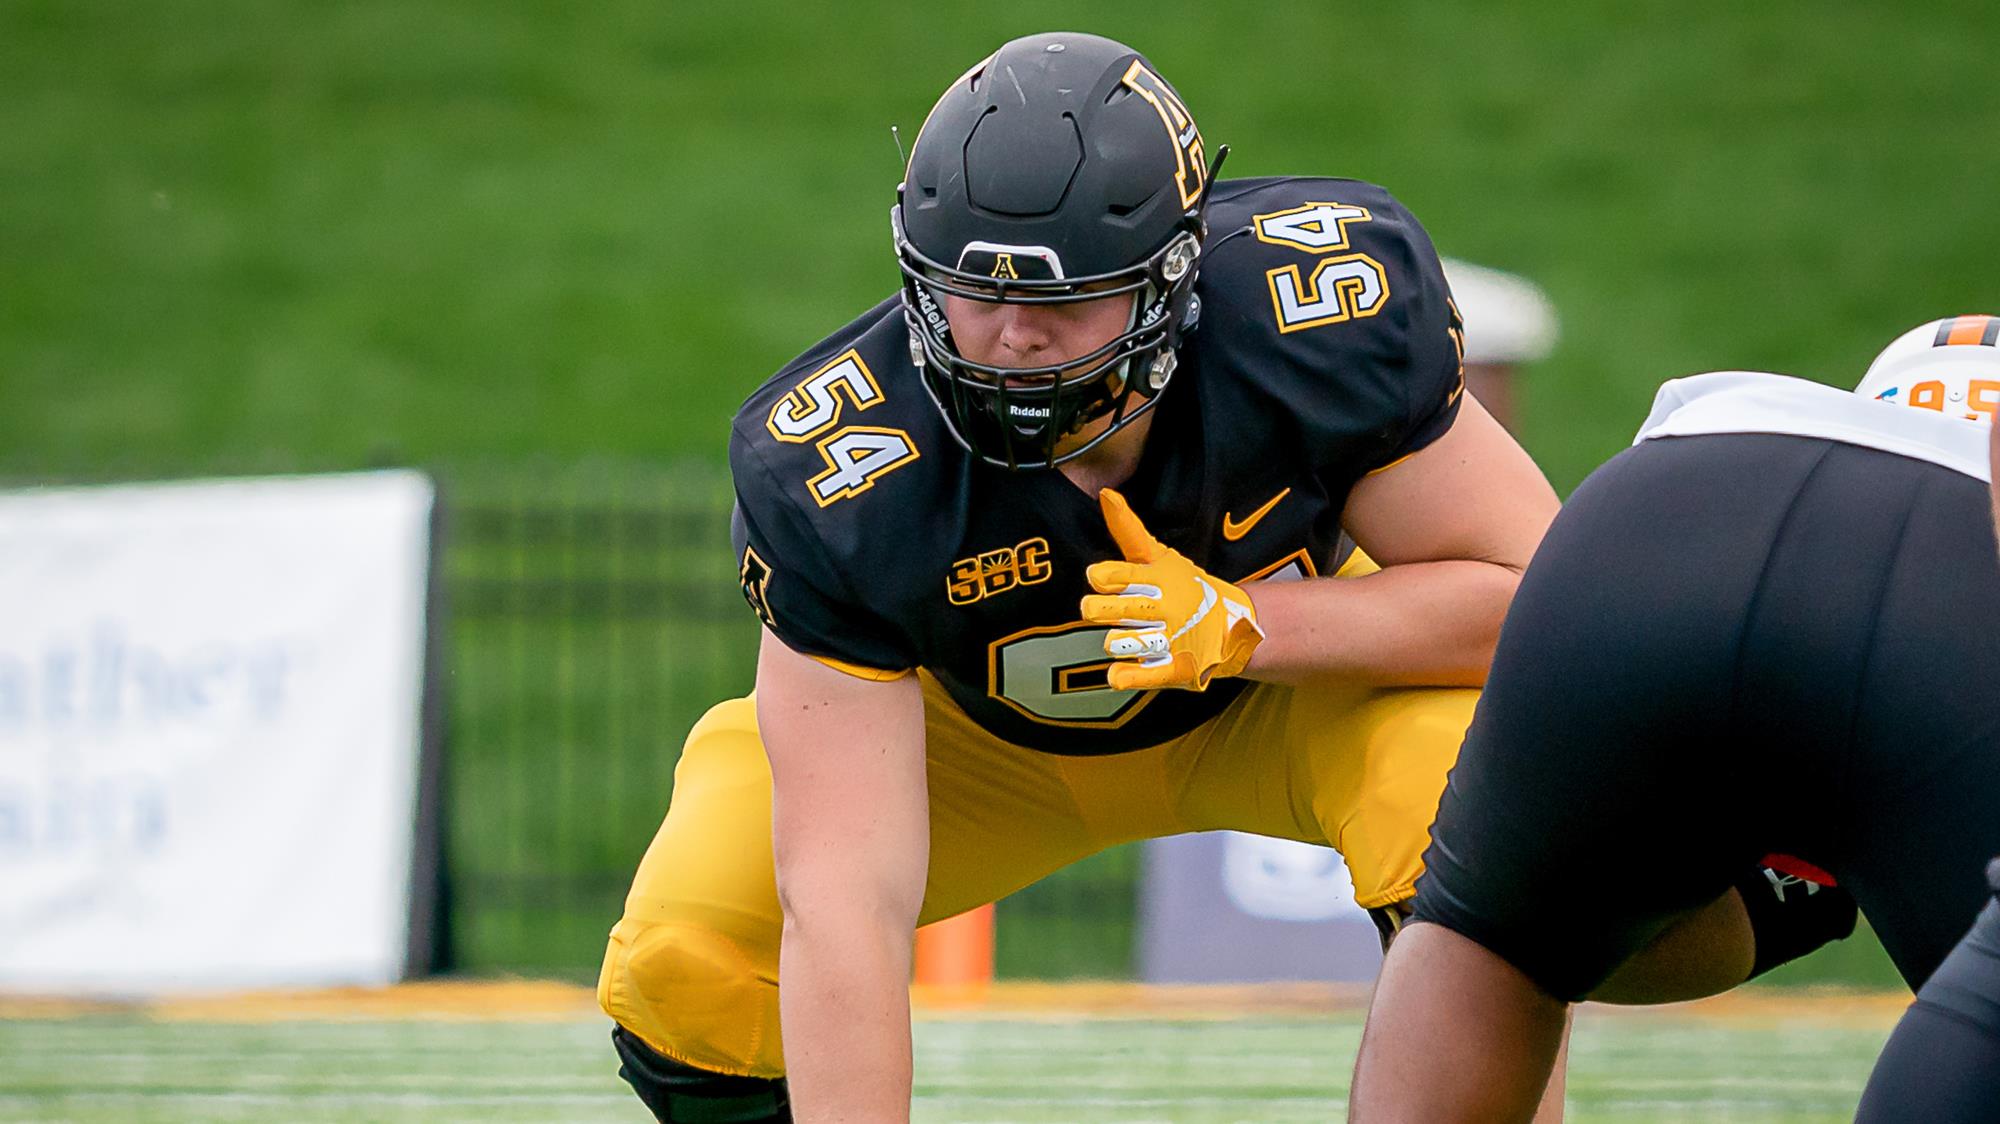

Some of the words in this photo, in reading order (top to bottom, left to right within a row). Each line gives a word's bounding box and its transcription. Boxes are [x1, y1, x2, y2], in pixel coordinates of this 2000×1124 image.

[991, 253, 1018, 280] A
[1252, 201, 1391, 334] 54
[765, 348, 921, 508] 54
[1009, 404, 1050, 418] Riddell
[946, 537, 1052, 605] SBC
